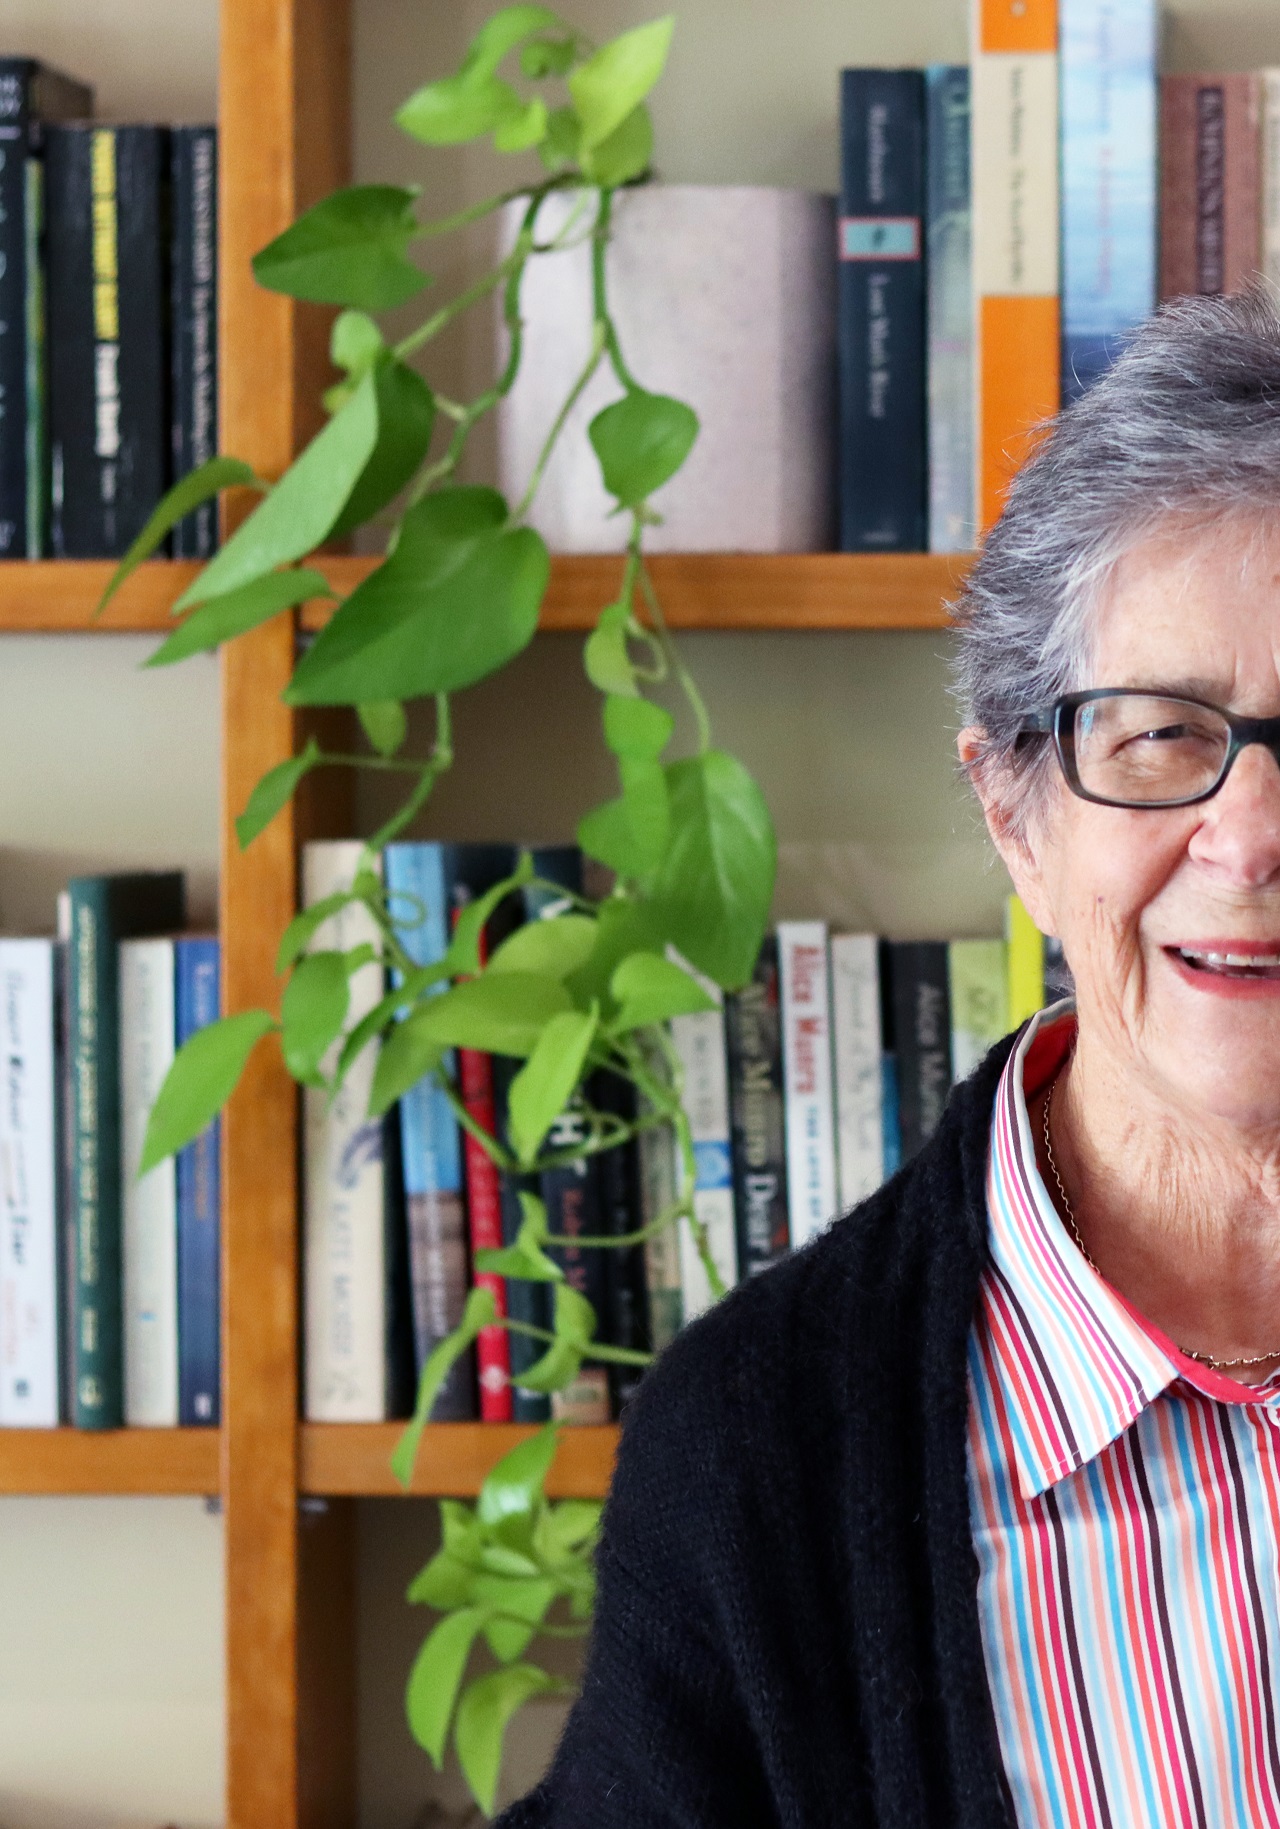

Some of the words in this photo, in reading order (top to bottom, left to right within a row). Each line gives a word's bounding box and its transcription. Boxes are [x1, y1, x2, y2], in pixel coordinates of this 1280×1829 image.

[92, 131, 118, 194] POWER
[92, 199, 118, 279] WITHOUT
[92, 283, 118, 341] GLORY
[792, 944, 822, 1004] Alice
[918, 983, 943, 1046] Alice
[795, 1017, 824, 1096] Munro
[917, 1051, 944, 1138] Munro
[743, 1061, 773, 1167] Munro
[747, 1173, 779, 1250] Dear
